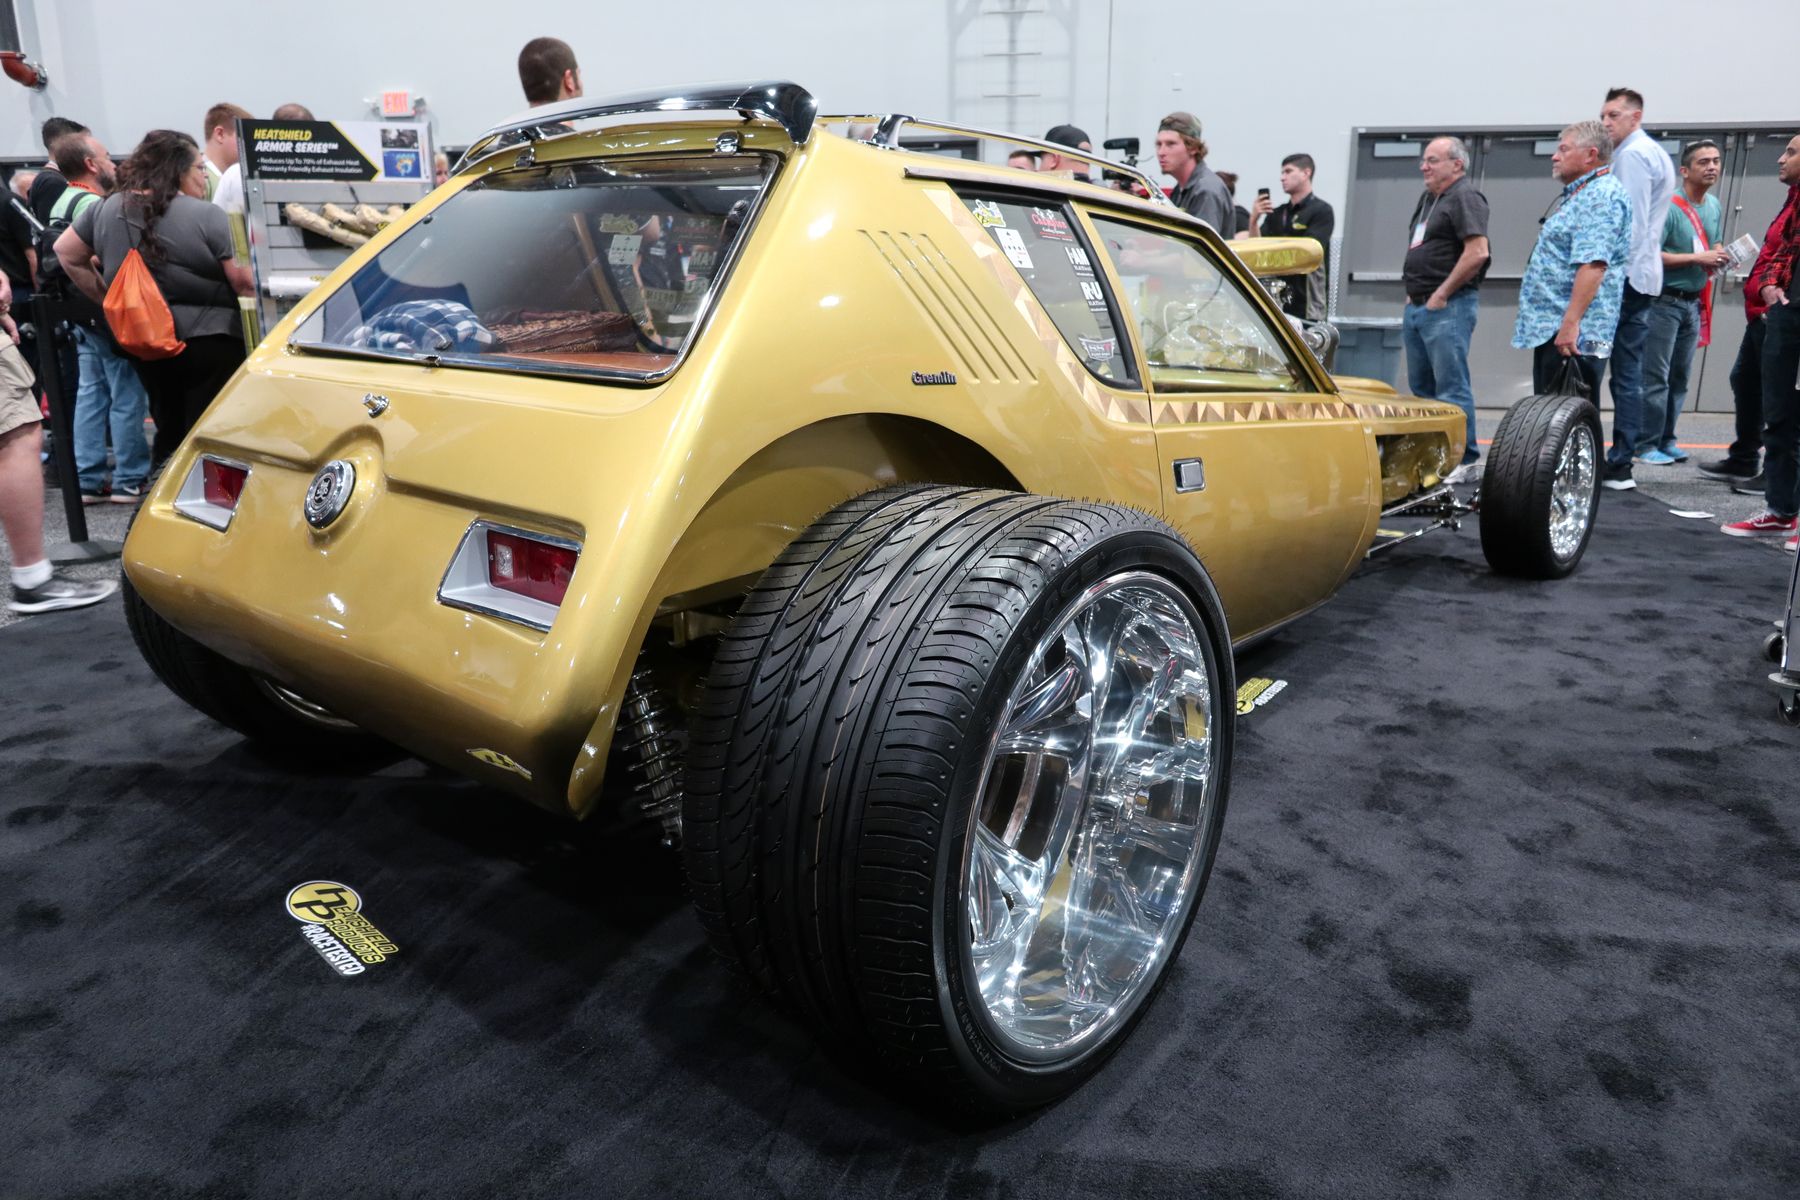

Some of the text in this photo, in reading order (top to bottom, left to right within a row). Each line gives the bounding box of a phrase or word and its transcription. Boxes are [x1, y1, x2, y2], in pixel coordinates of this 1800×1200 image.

[384, 92, 409, 113] EXIT
[254, 129, 312, 141] HEATSHIELD
[255, 141, 293, 153] ARMOR
[912, 371, 957, 385] Gremlin
[300, 923, 366, 975] #RACETESTED
